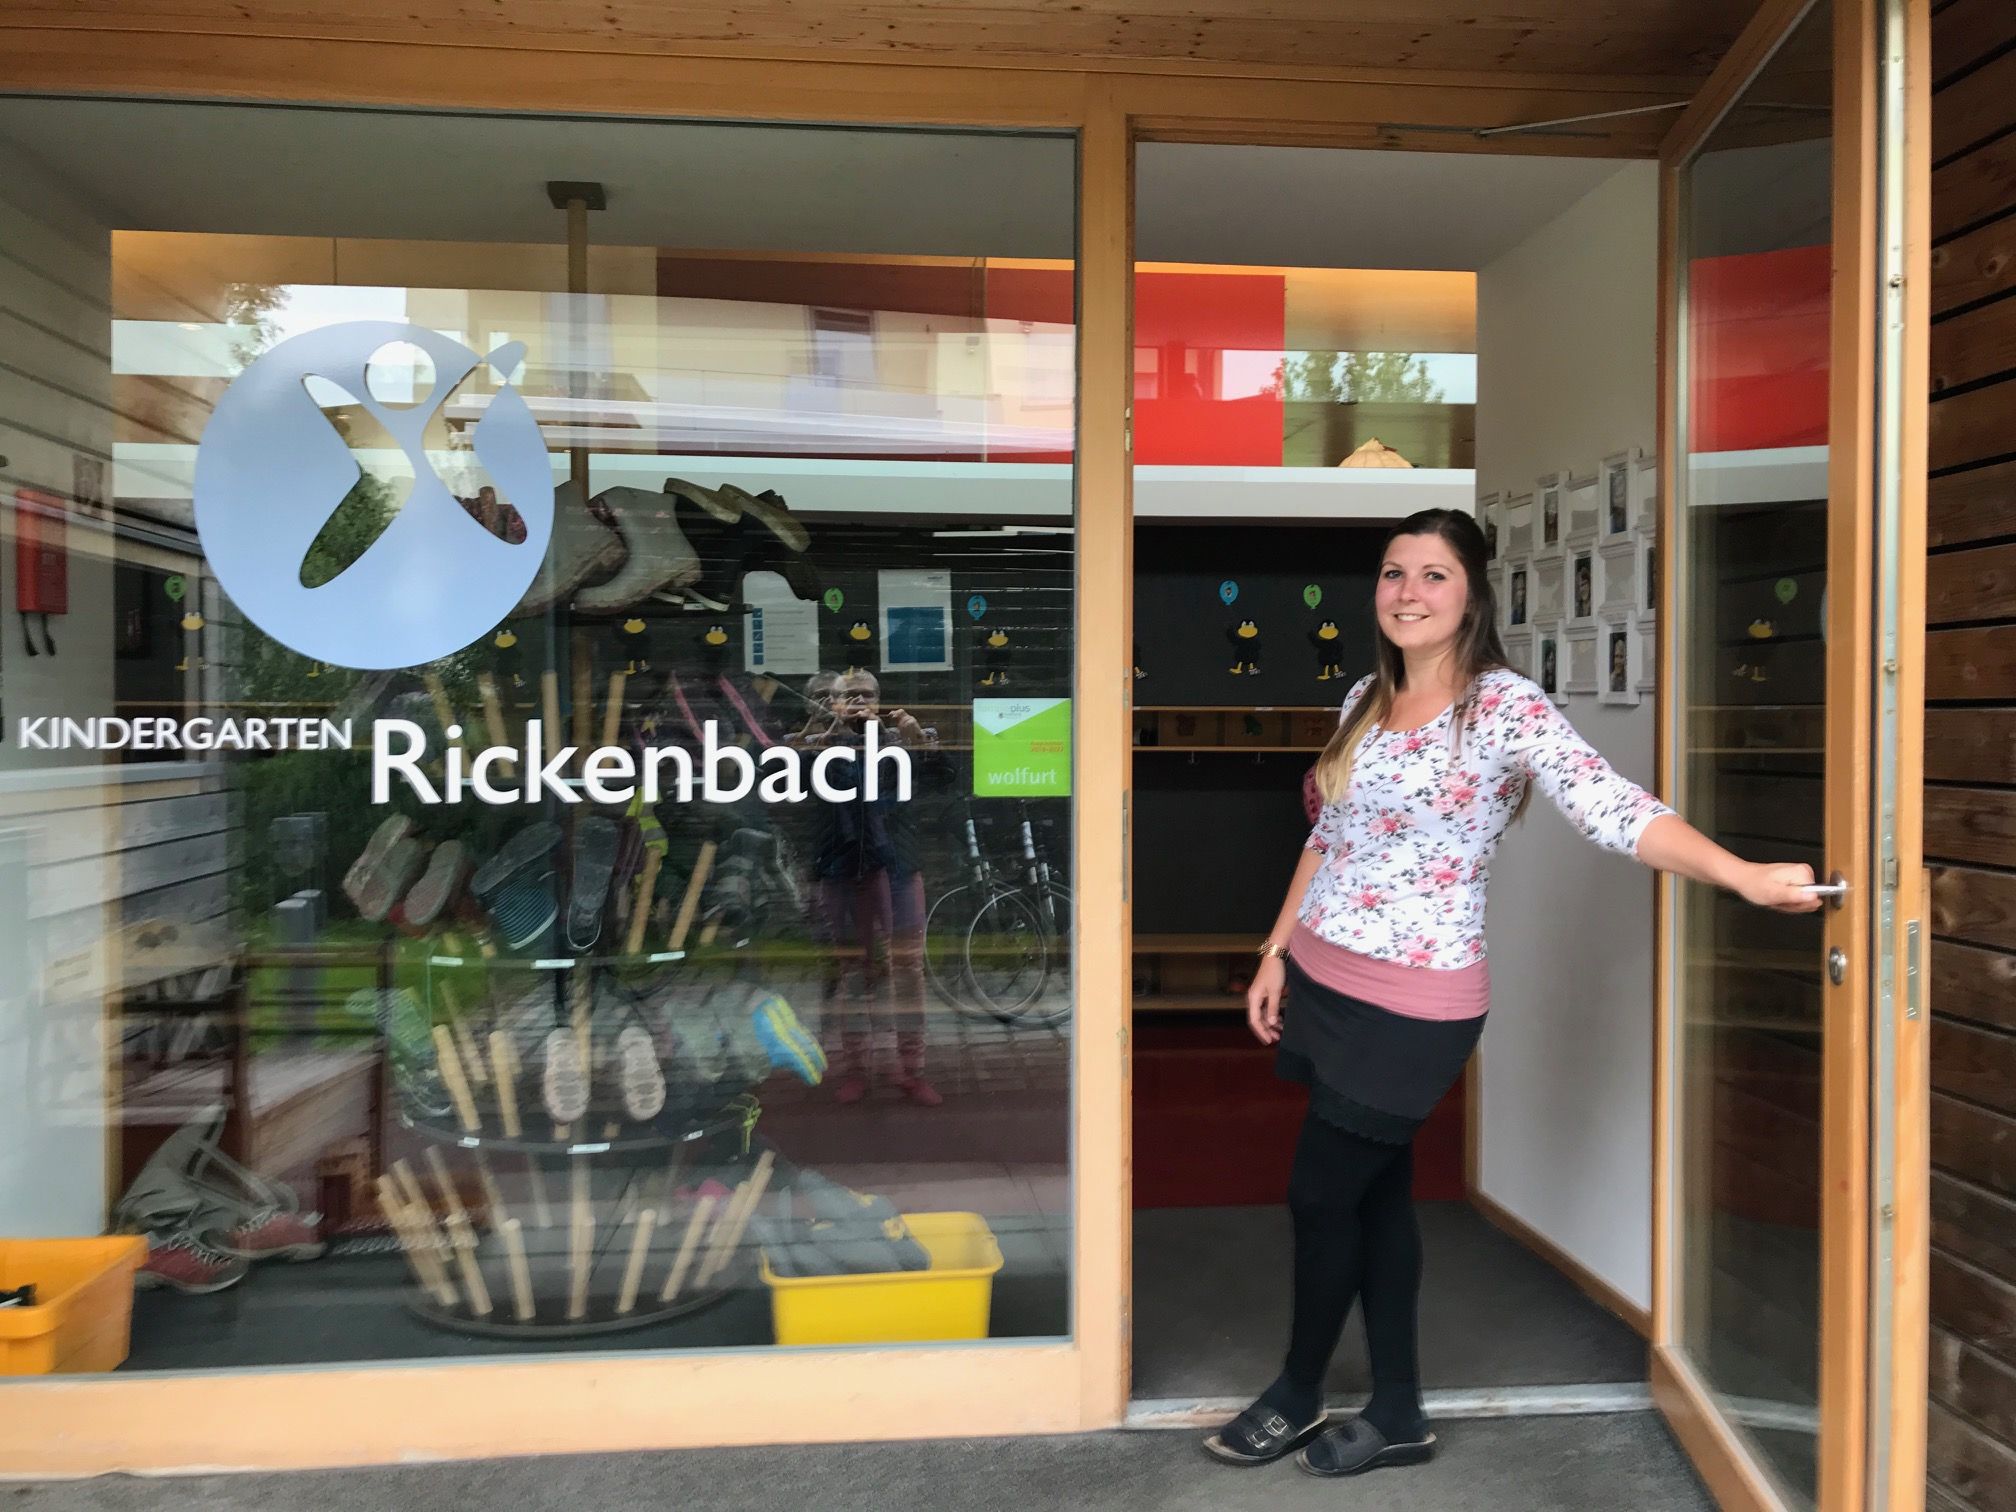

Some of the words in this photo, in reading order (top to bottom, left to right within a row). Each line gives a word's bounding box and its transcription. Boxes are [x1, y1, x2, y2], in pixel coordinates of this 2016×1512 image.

[19, 716, 353, 750] KINDERGARTEN
[371, 719, 913, 804] Rickenbach
[988, 767, 1057, 785] wolfurt
